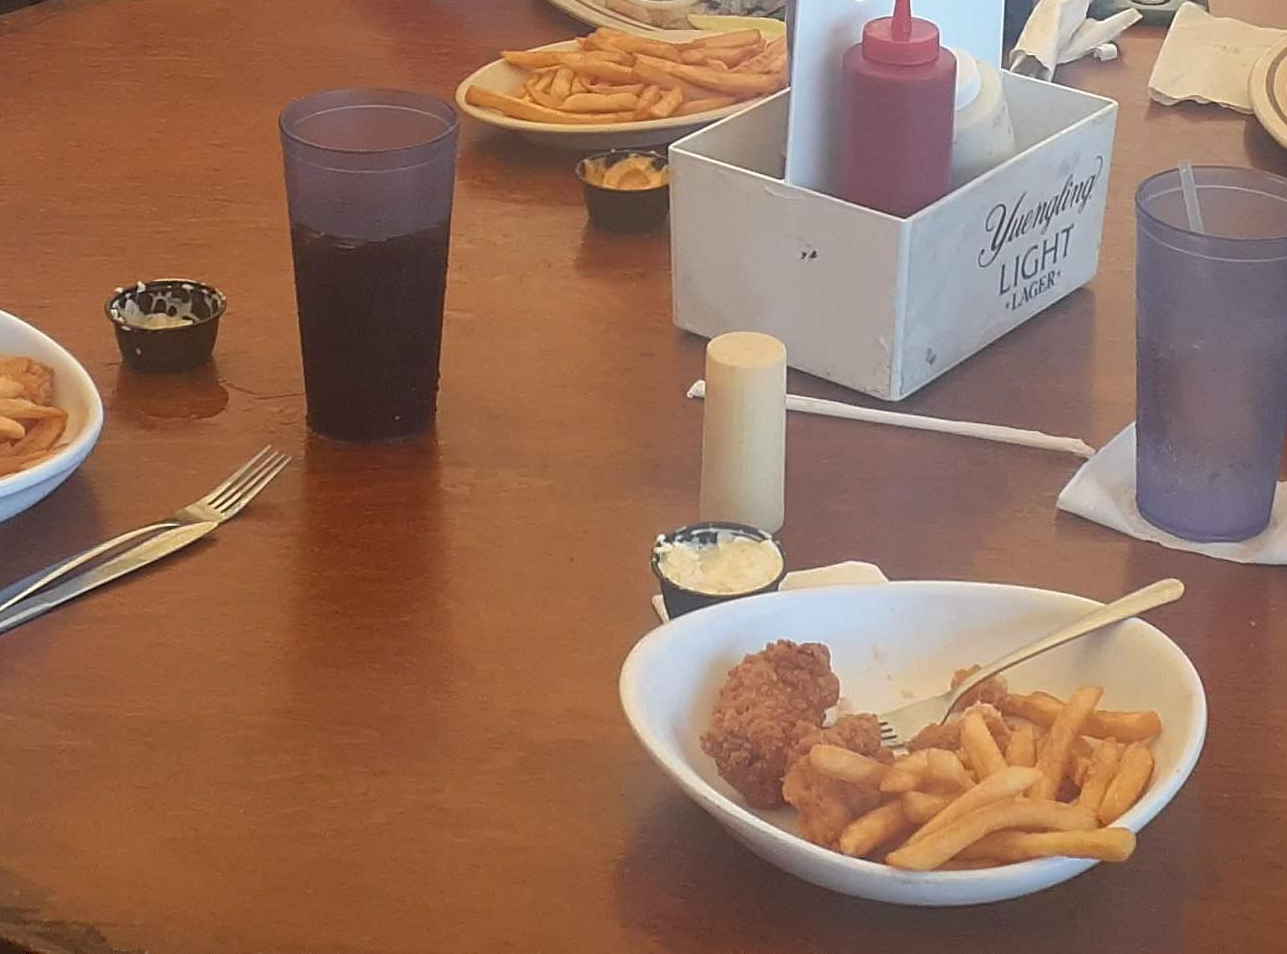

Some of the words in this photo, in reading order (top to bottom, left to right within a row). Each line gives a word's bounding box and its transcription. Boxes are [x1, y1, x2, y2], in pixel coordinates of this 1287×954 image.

[977, 155, 1104, 268] Yuengling
[999, 221, 1075, 296] LIGHT
[1011, 269, 1057, 311] LAGER
